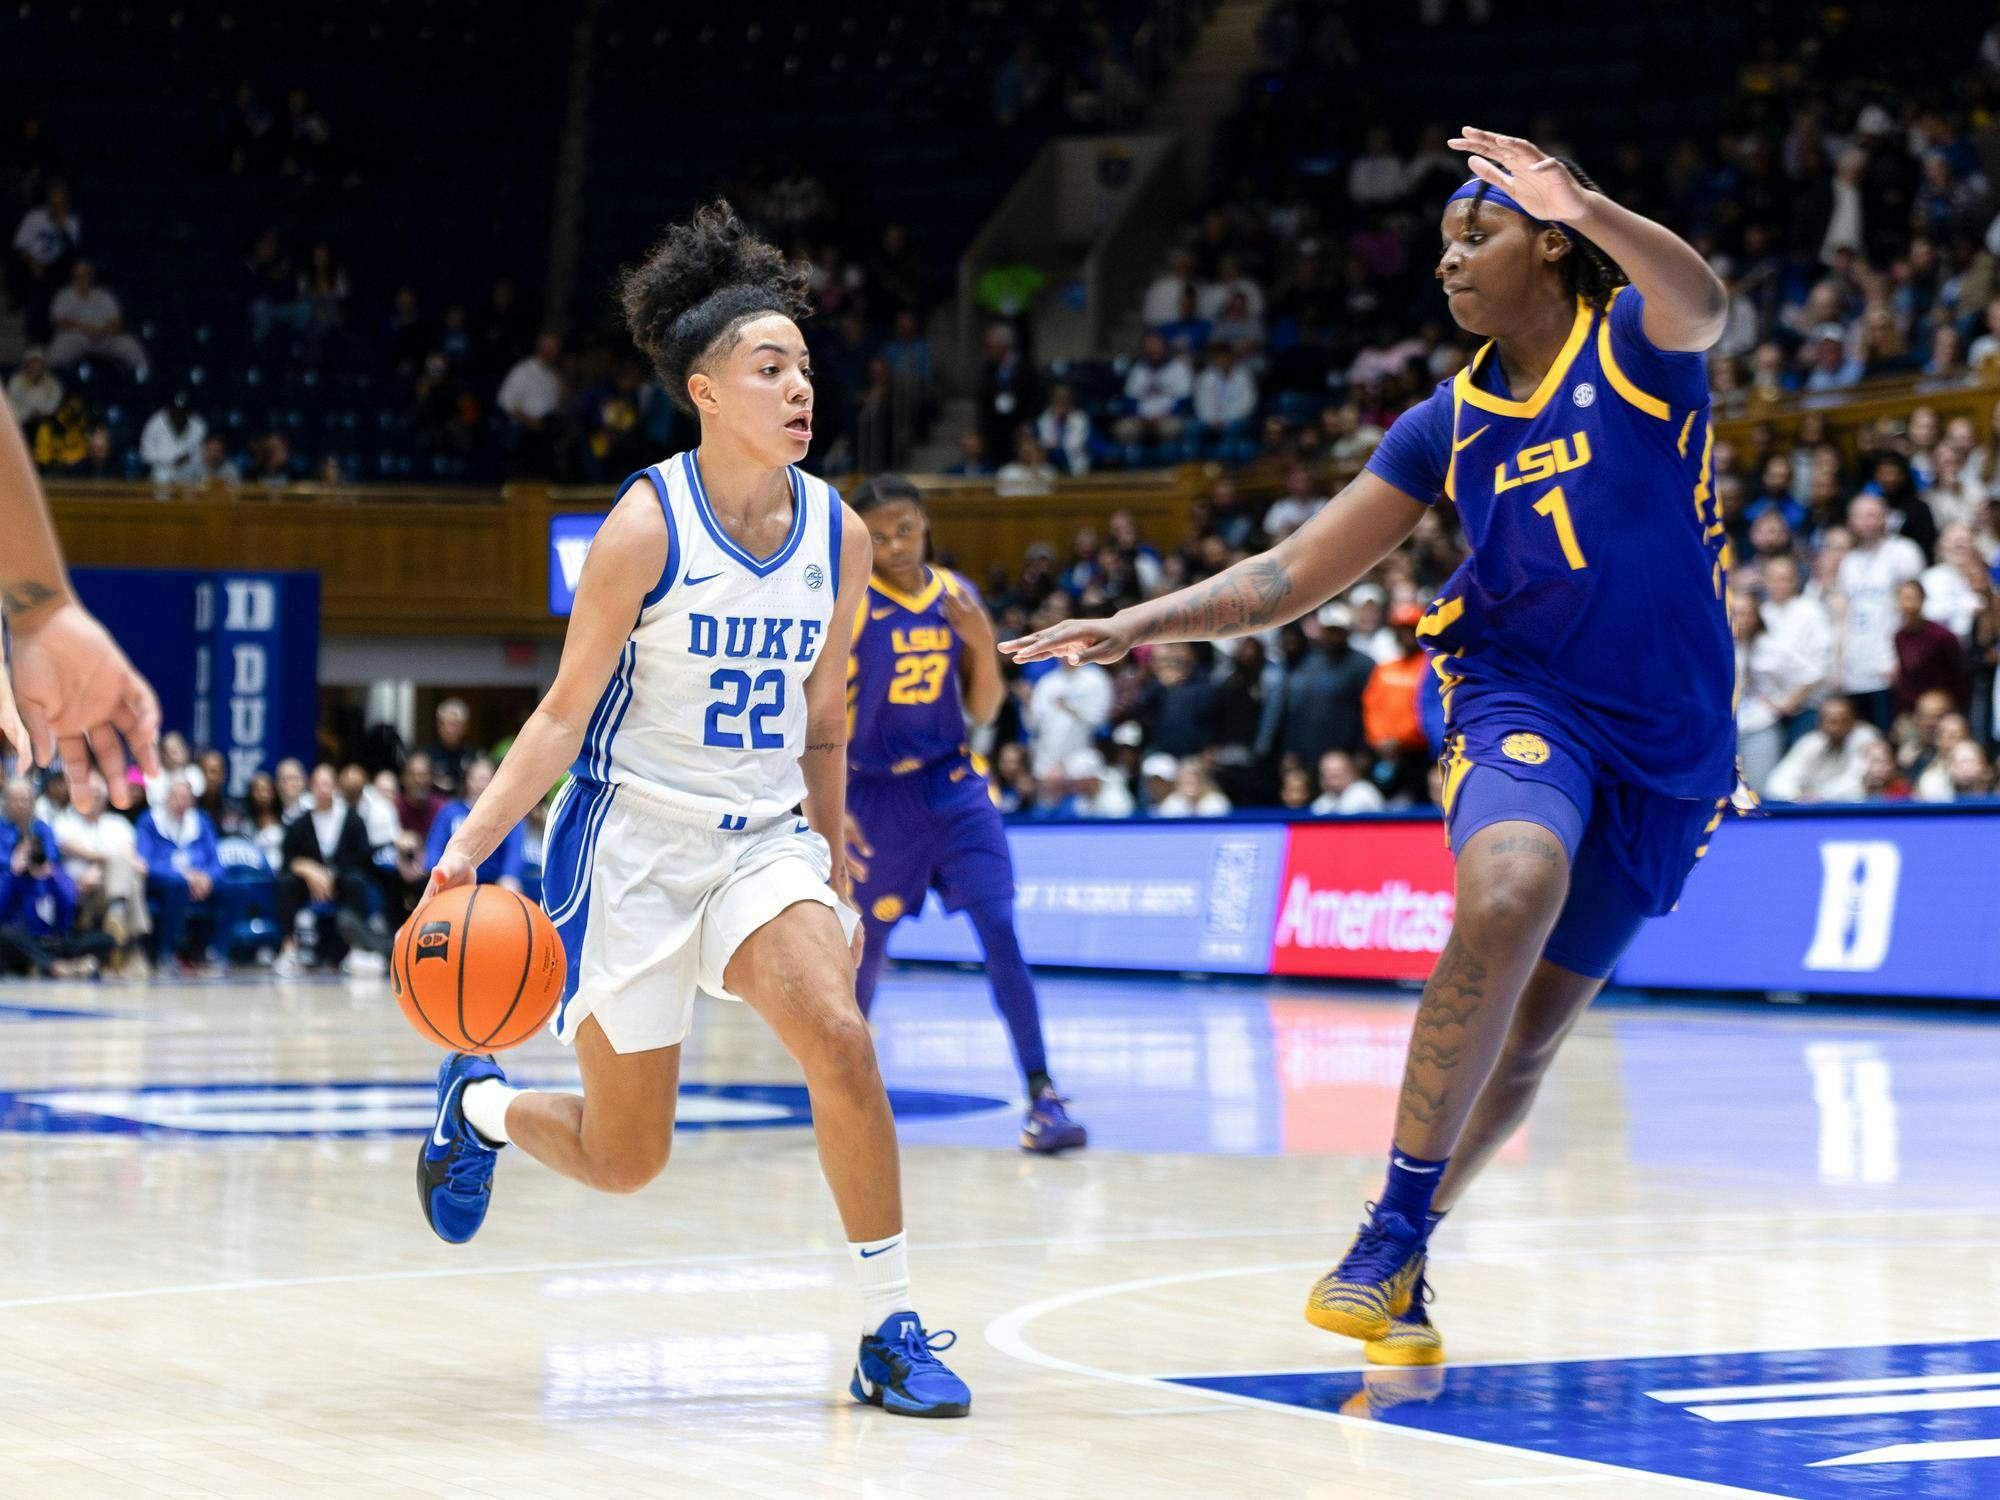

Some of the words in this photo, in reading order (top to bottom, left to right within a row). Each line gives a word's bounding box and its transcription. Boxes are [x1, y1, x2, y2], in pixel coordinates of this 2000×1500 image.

[1494, 431, 1592, 495] LSU
[1532, 486, 1588, 570] 1
[224, 579, 276, 632] D
[688, 613, 821, 662] DUKE
[891, 625, 953, 654] LSU
[703, 668, 786, 749] 22
[888, 652, 951, 705] 23
[1275, 874, 1456, 952] Ameritas
[1803, 839, 1902, 972] D
